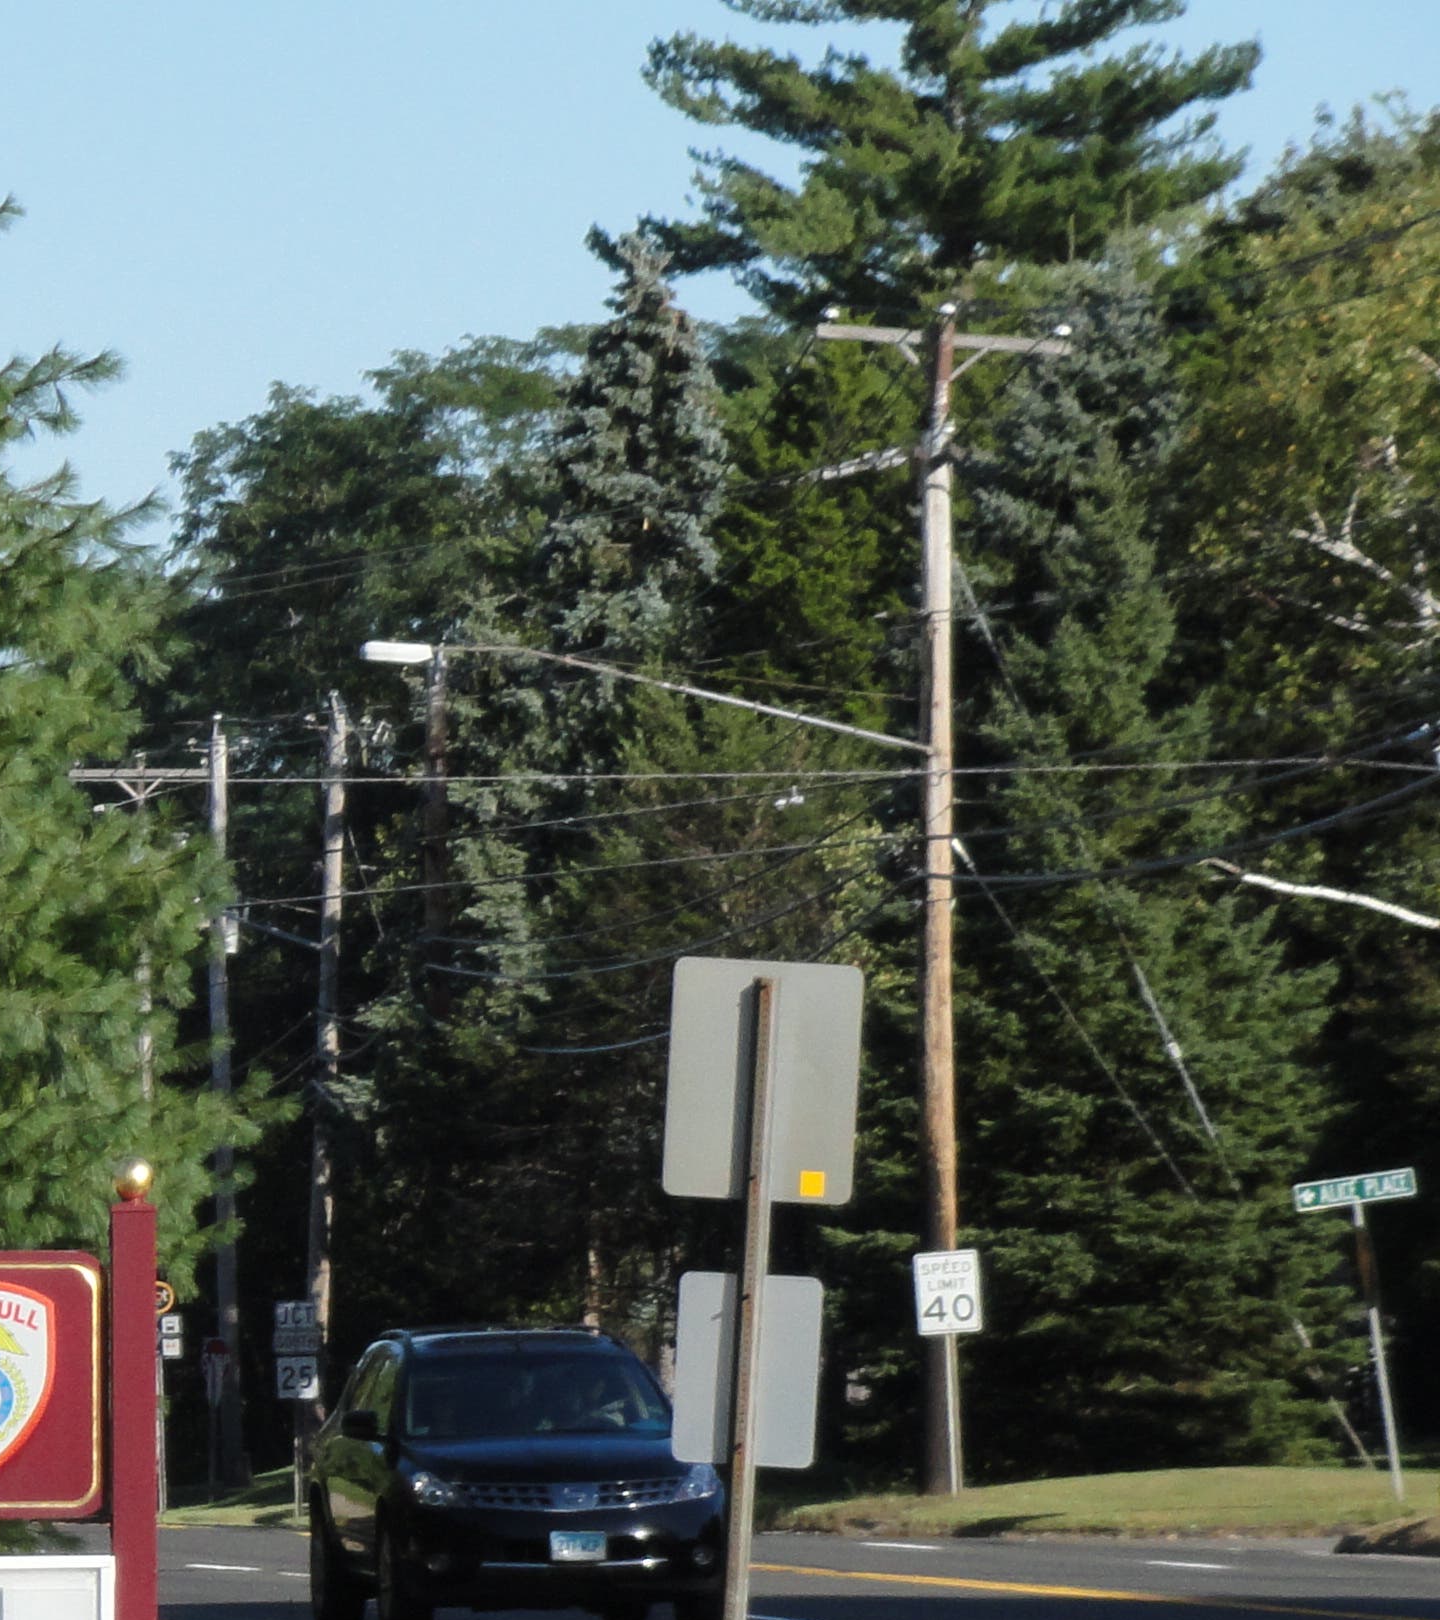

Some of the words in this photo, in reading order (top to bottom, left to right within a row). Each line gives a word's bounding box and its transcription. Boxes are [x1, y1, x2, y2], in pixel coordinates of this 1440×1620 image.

[921, 1261, 972, 1276] SPEED
[928, 1277, 967, 1292] LIMIT
[280, 1305, 313, 1325] JCT
[923, 1294, 975, 1323] 40
[282, 1365, 313, 1391] 25
